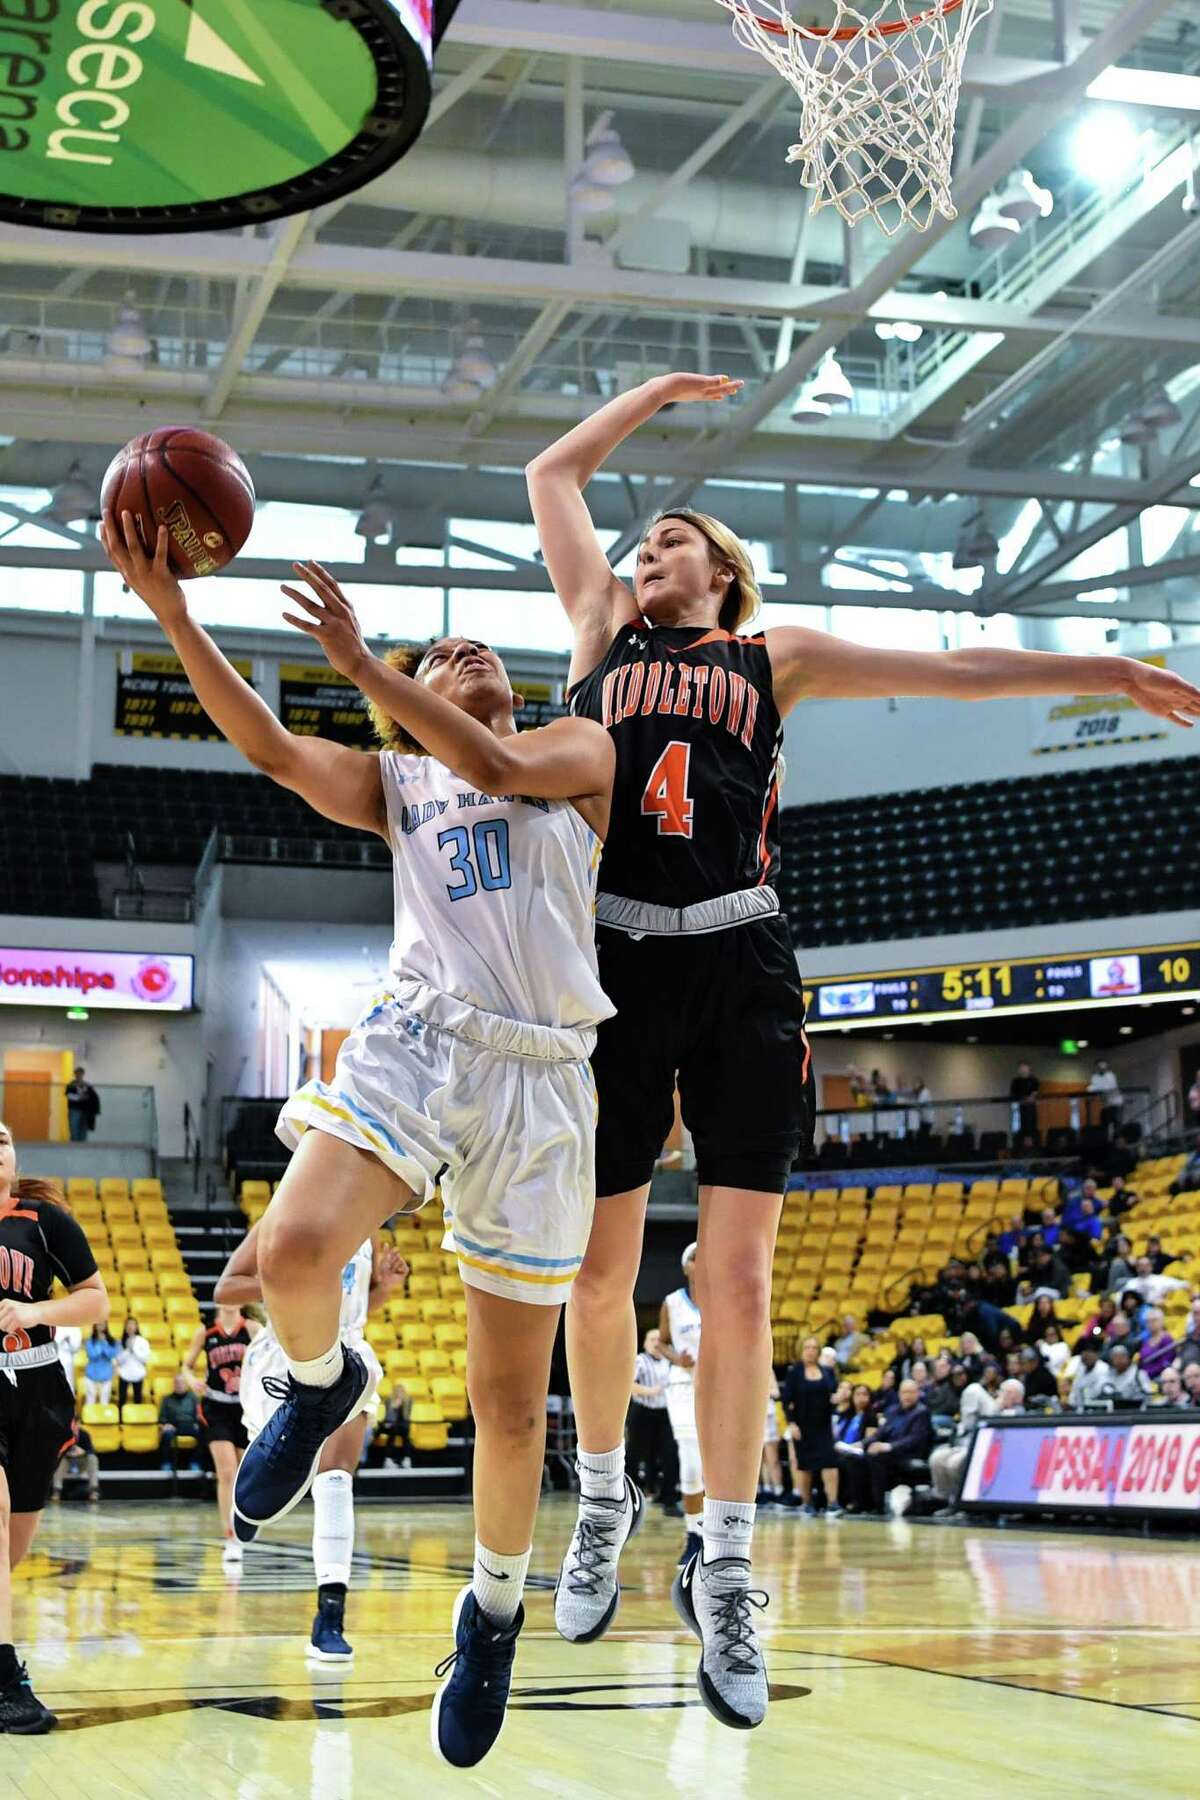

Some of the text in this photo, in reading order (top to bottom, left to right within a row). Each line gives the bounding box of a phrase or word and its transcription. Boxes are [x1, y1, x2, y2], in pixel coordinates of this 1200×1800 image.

[46, 0, 154, 165] secu
[641, 740, 694, 839] 4
[437, 818, 512, 902] 30
[0, 964, 115, 995] onships
[941, 966, 1012, 1001] 5:11
[1159, 956, 1191, 984] 10
[1122, 1434, 1182, 1492] 2019
